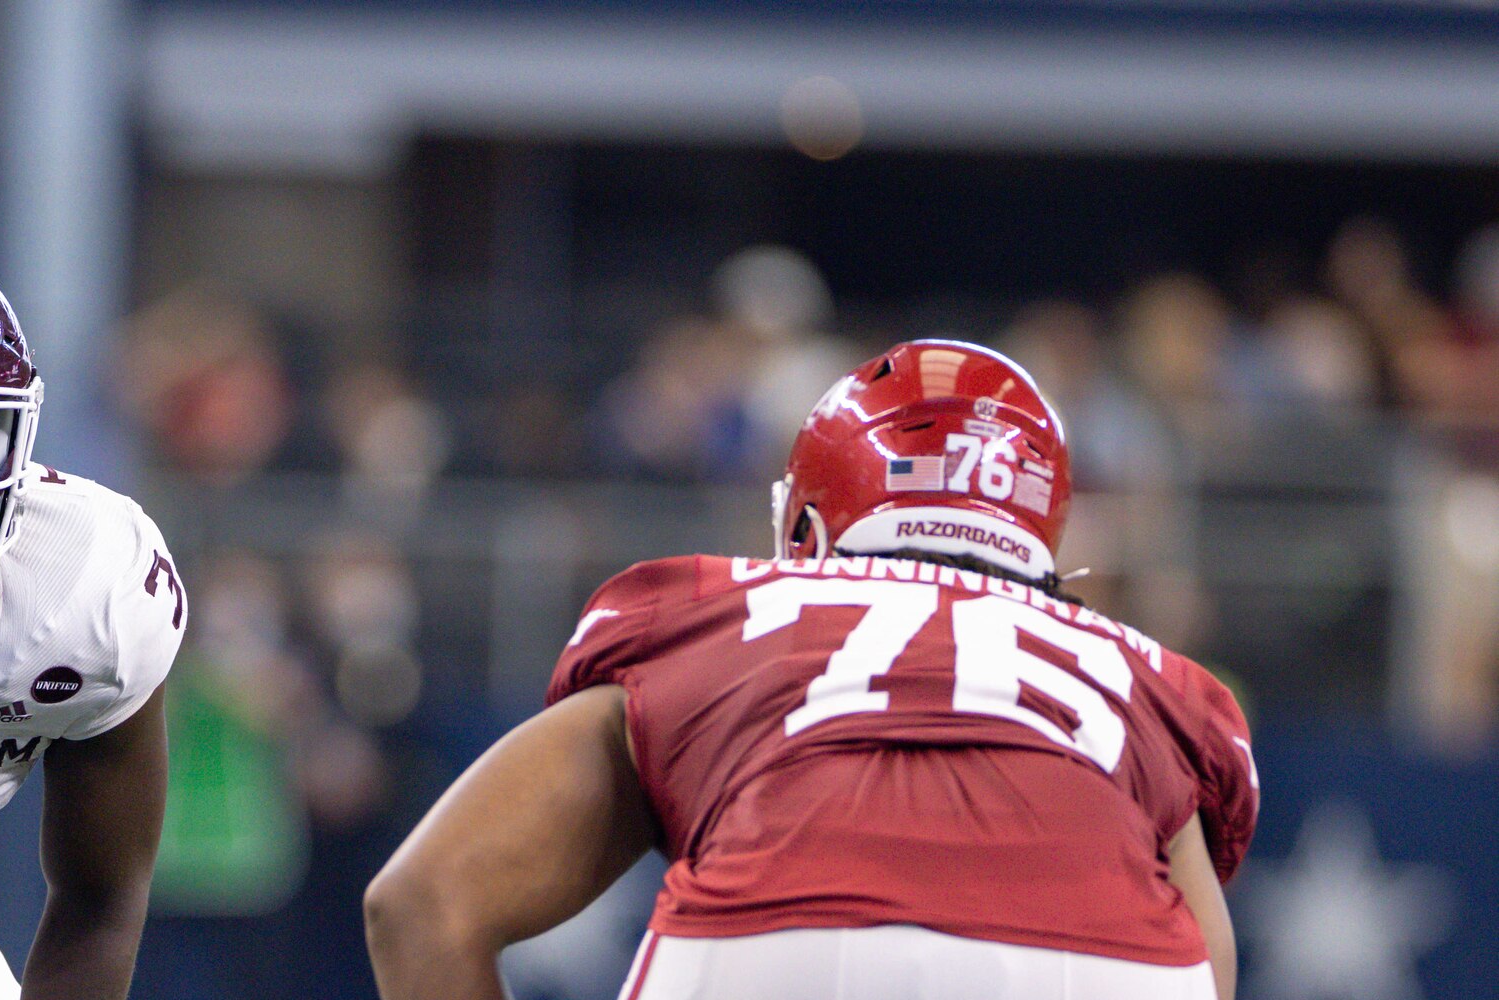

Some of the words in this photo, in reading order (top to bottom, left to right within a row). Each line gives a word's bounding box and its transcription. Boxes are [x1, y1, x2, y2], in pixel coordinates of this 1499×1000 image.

[945, 433, 1017, 501] 76
[896, 521, 1031, 564] RAZORBACKS
[35, 680, 80, 691] UNIFIED
[743, 577, 1133, 773] 76
